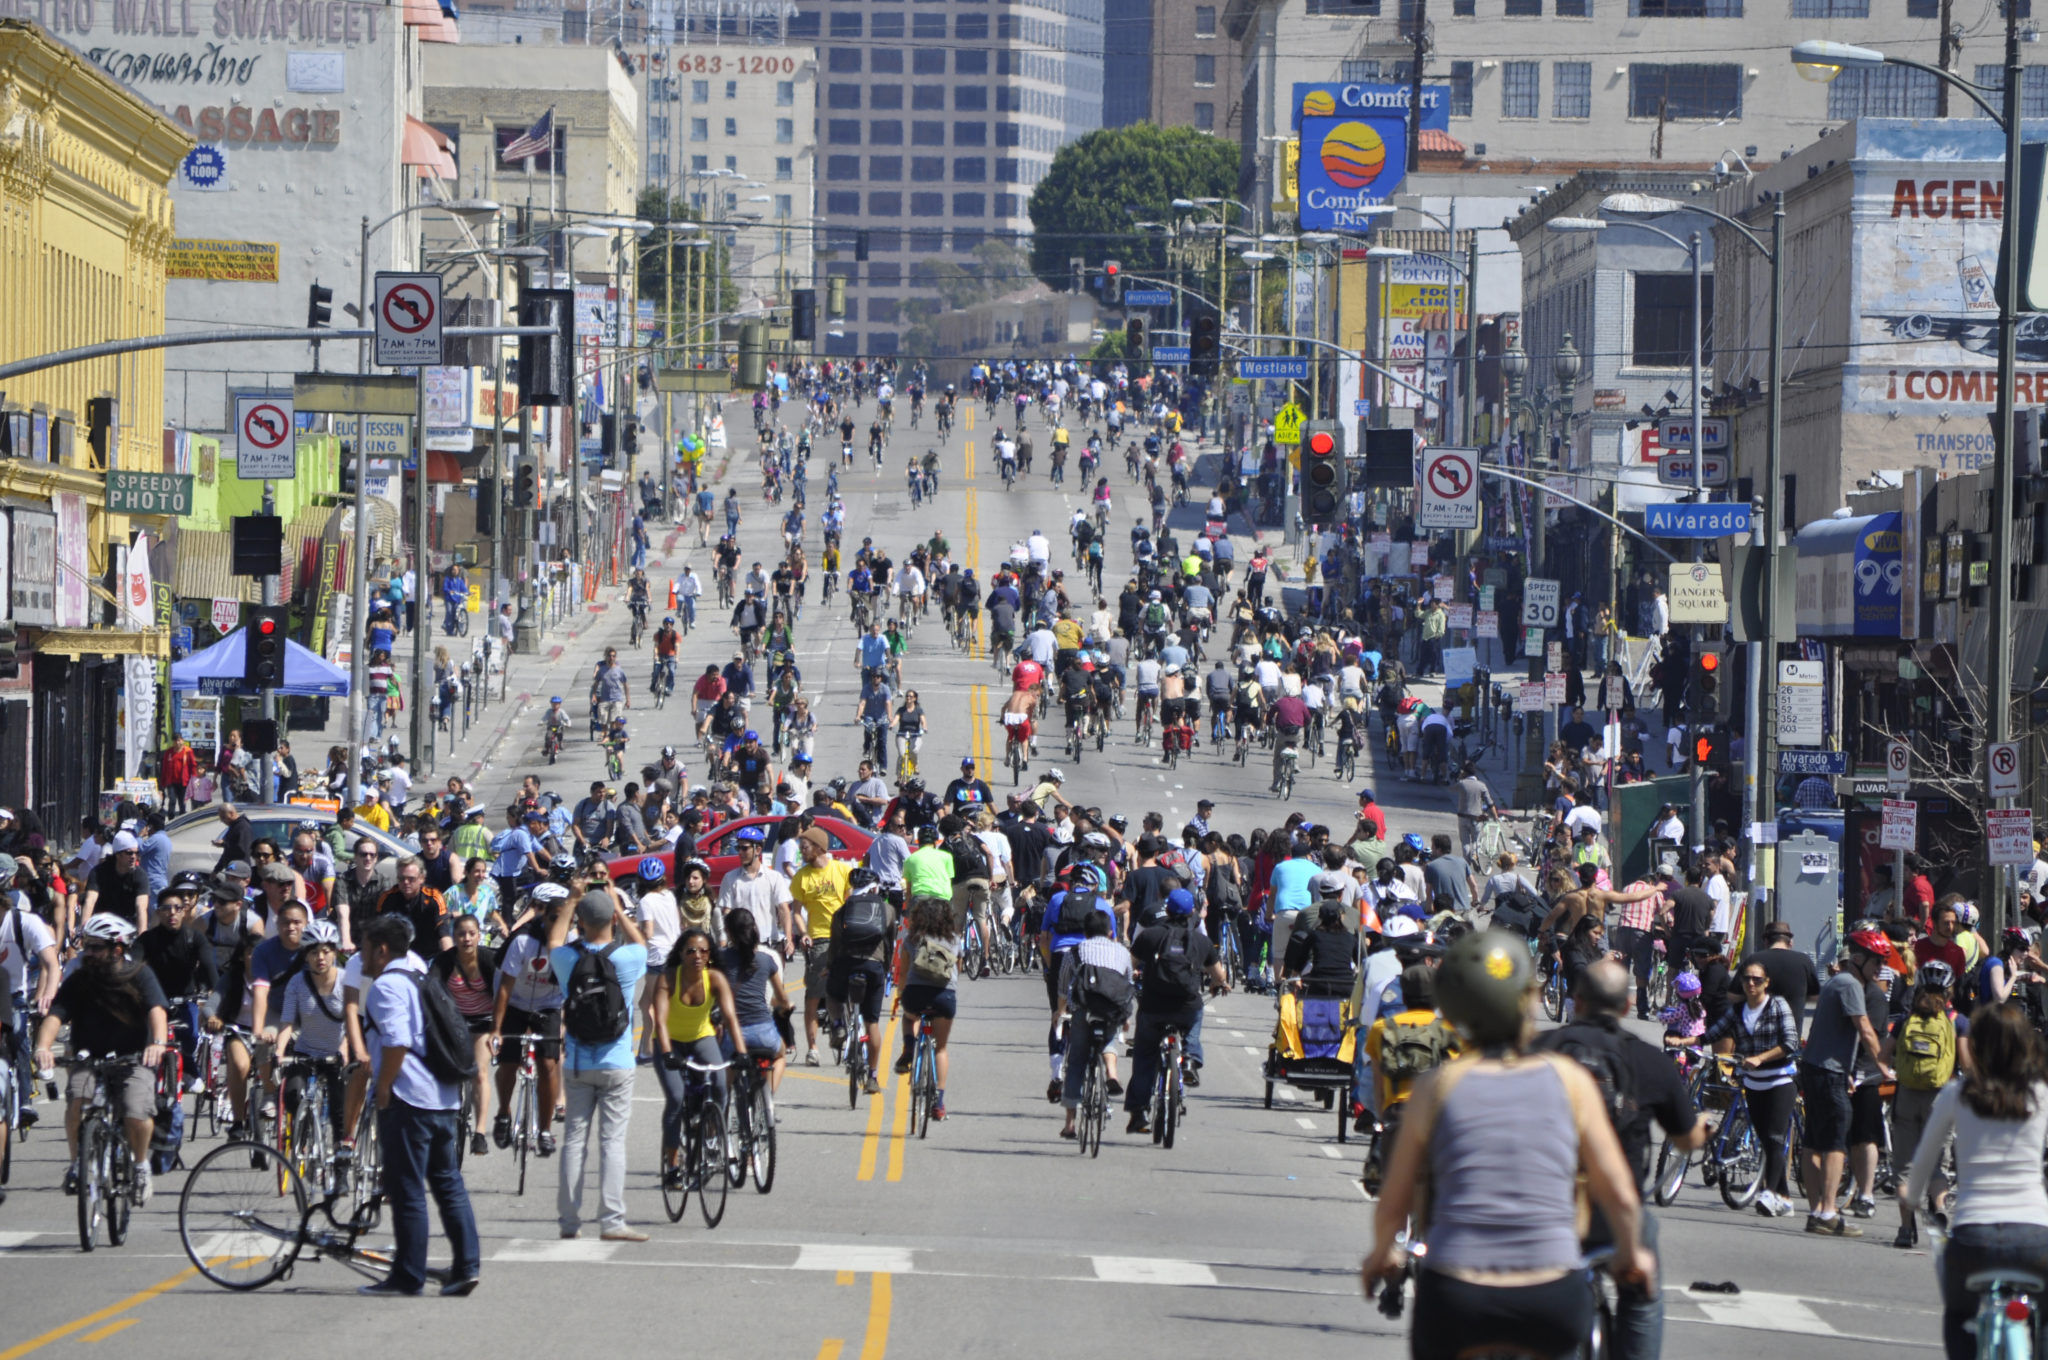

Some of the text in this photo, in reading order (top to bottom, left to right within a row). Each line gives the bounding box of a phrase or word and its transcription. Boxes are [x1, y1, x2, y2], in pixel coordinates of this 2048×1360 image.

[113, 0, 199, 36] MALL
[214, 0, 382, 43] SWAPMEET
[677, 54, 795, 74] 683-1200
[160, 105, 340, 144] ASSAGE
[196, 153, 212, 165] 3RD
[190, 165, 218, 178] FLOOR
[167, 241, 194, 251] ADO
[1402, 268, 1460, 282] DENTIT
[1968, 302, 1997, 310] TRAVEL
[381, 339, 388, 348] 7
[390, 339, 405, 348] AM
[414, 339, 421, 348] 7
[422, 339, 436, 348] PM
[1155, 351, 1189, 361] Bonnie
[1245, 361, 1303, 374] Westlake
[1277, 431, 1301, 441] AHEA
[243, 455, 248, 463] 7
[250, 455, 263, 463] AM
[271, 455, 277, 463] 7
[277, 455, 289, 463] PM
[1939, 453, 1948, 469] Y
[117, 475, 183, 492] SPEEDY
[110, 491, 185, 511] PHOTO
[1426, 503, 1431, 512] 7
[1433, 504, 1446, 513] AM
[1454, 503, 1459, 513] 7
[1460, 505, 1473, 513] PM
[1651, 512, 1746, 529] Alvarado
[1872, 534, 1900, 549] VIVA
[1853, 559, 1902, 597] 99
[1527, 583, 1557, 592] SPEED
[213, 601, 237, 616] ATM
[1677, 600, 1719, 609] SQUARE
[1527, 603, 1555, 622] 30
[1781, 706, 1792, 714] 52
[1782, 752, 1843, 764] Alvarado St
[1782, 763, 1796, 771] 700
[1855, 784, 1889, 793] ALVAR
[1883, 812, 1893, 824] NO
[1988, 824, 2030, 838] NO STOPPING
[2013, 838, 2028, 848] 4PM
